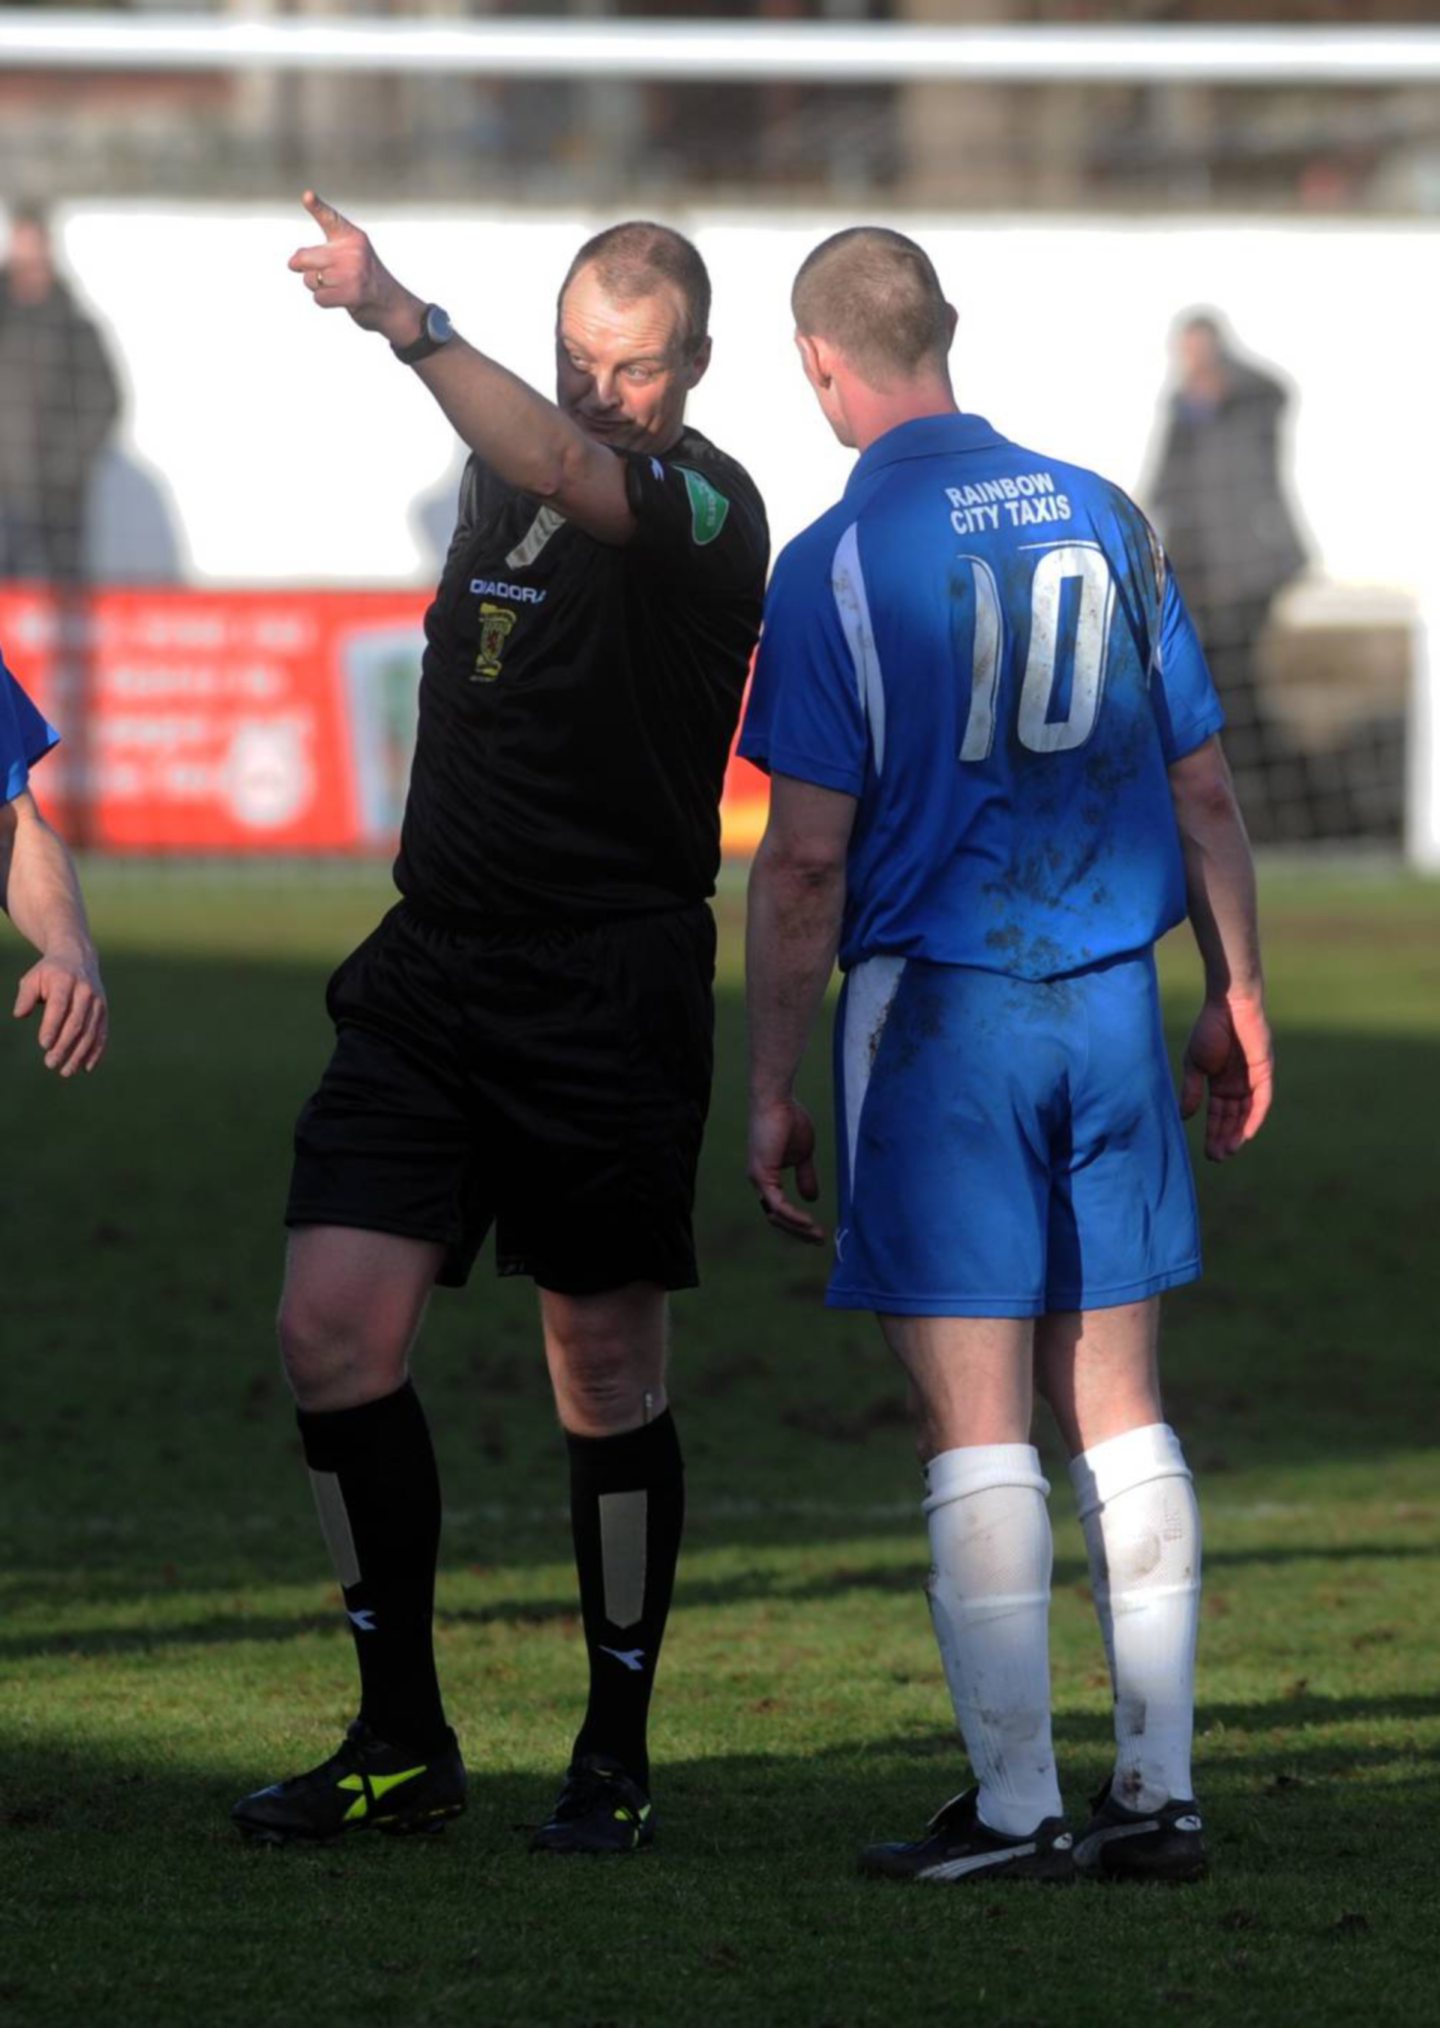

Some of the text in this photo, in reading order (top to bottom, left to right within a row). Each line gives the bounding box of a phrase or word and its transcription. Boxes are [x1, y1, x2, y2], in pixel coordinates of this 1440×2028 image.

[945, 473, 1055, 507] RAINBOW
[950, 495, 1071, 534] CITY TAXIS
[956, 540, 1116, 762] 10
